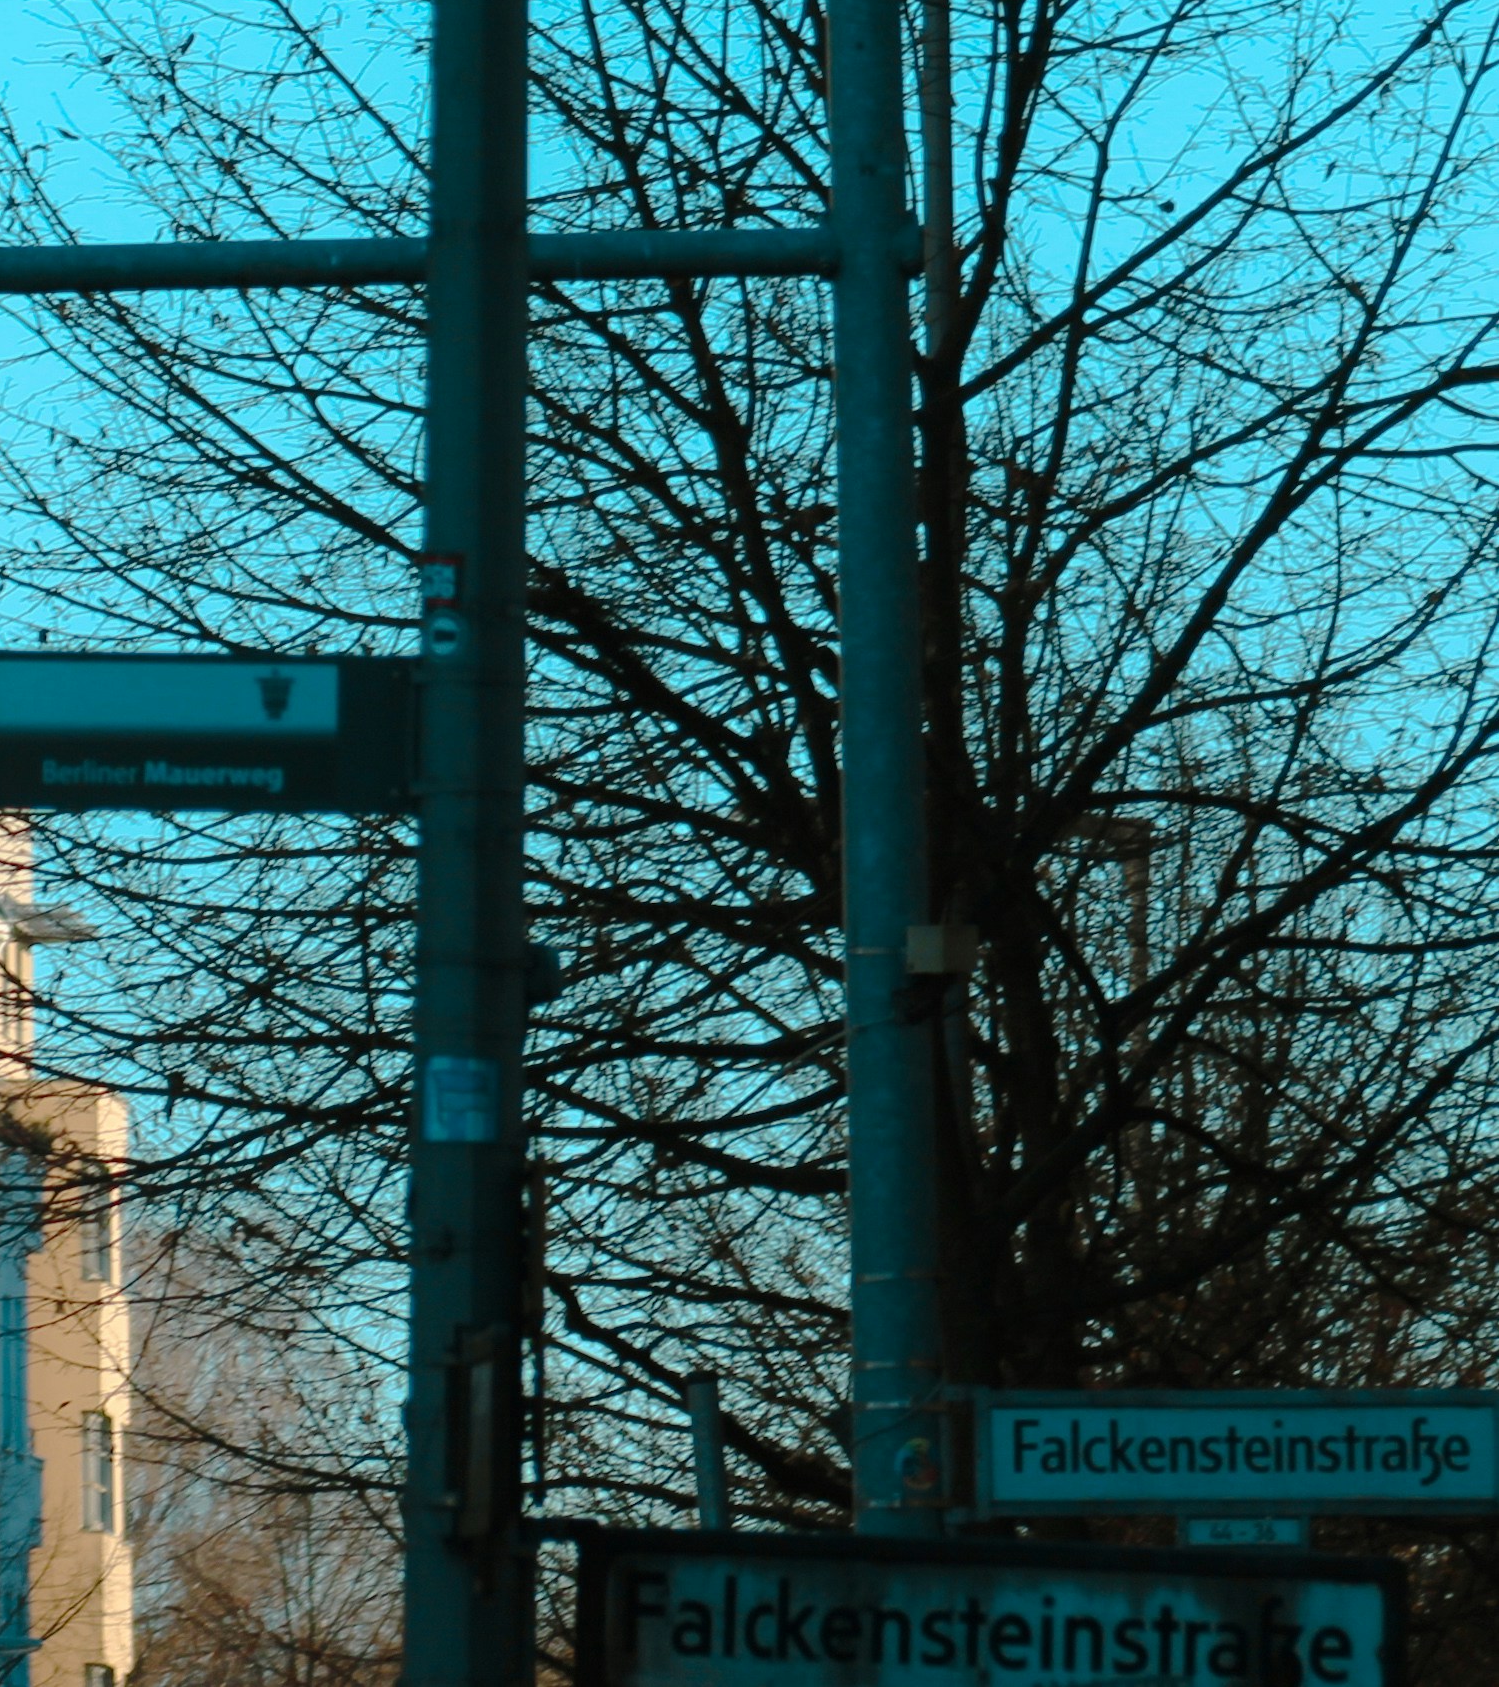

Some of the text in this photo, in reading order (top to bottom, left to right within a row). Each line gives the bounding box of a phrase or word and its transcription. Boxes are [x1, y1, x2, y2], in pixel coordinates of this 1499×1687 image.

[42, 758, 285, 794] Berliner Mauerweg
[1013, 1416, 1471, 1487] Falckensteinstraße
[623, 1570, 1353, 1687] Falckensteinstraße
